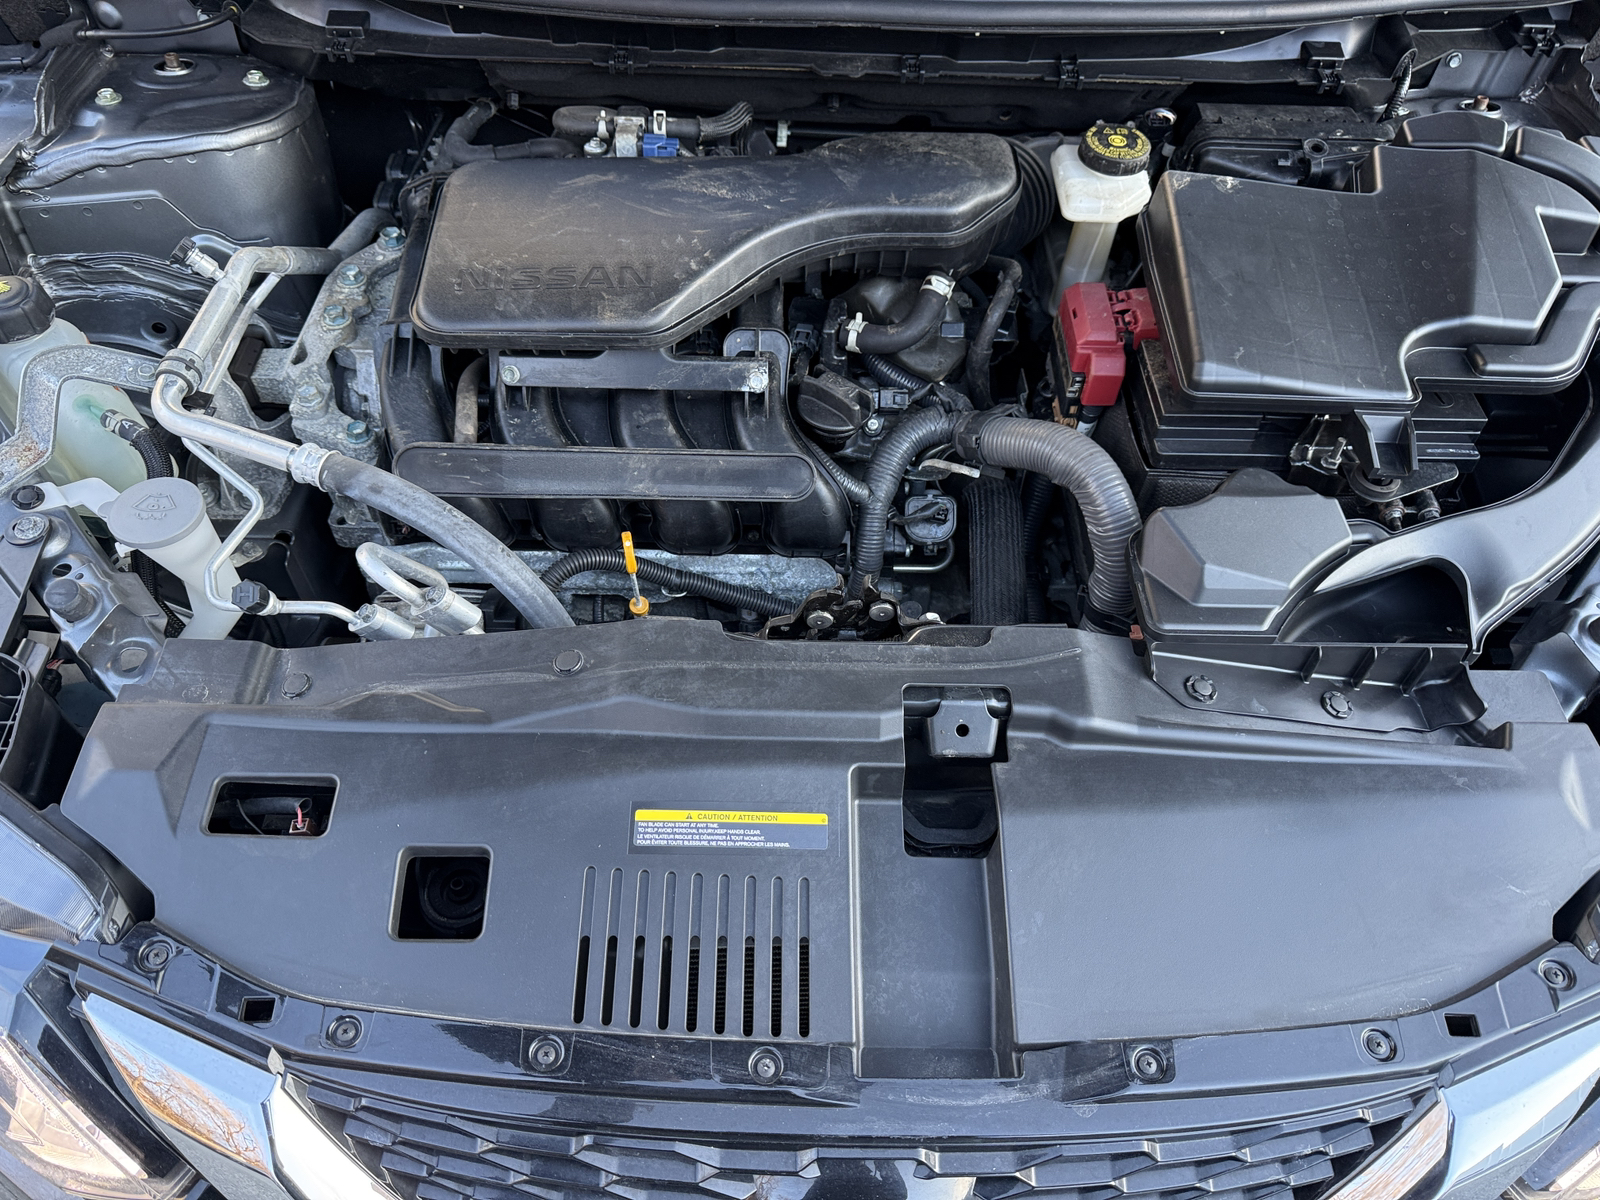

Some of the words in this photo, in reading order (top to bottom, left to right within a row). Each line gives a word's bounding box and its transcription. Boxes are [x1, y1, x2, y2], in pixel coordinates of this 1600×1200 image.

[454, 265, 653, 292] NISSAN
[122, 420, 134, 430] A
[236, 586, 254, 603] H
